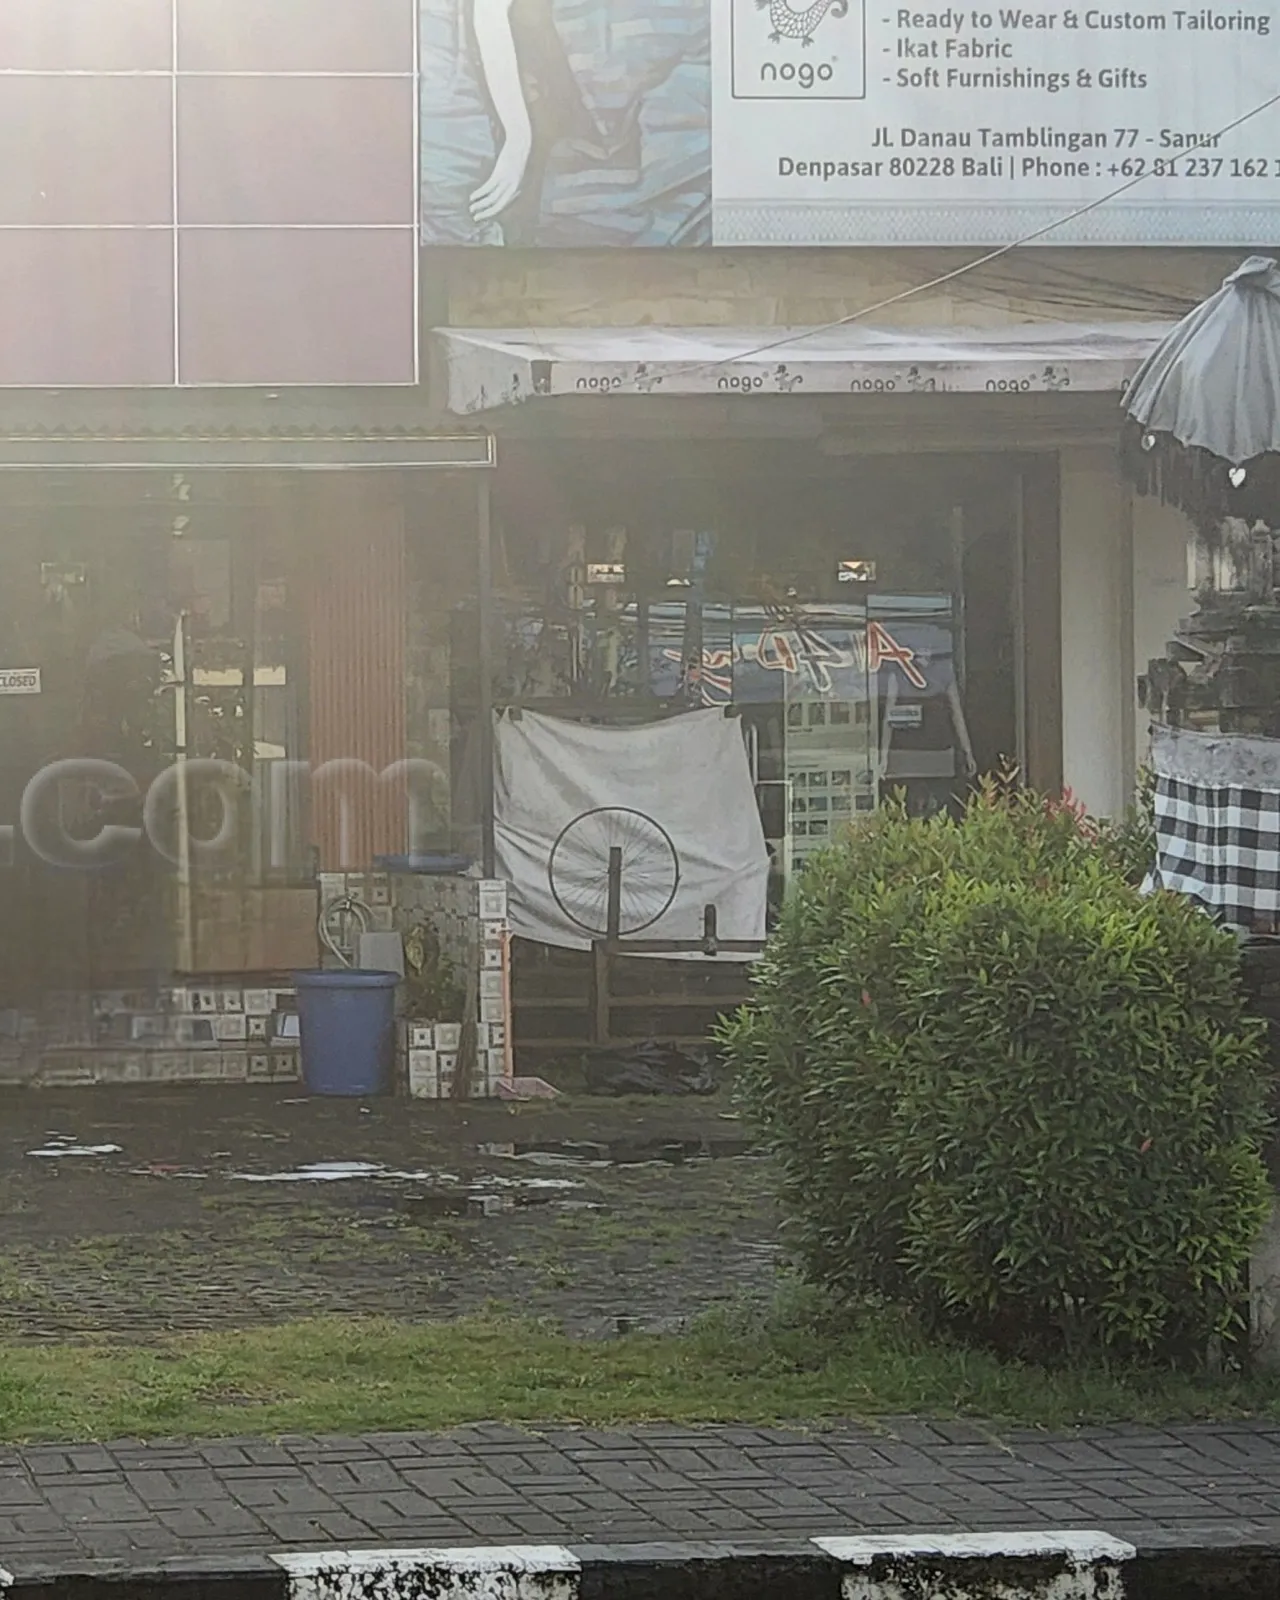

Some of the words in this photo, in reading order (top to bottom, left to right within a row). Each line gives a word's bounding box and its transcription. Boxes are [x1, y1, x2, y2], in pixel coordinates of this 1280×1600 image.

[897, 9, 964, 33] Ready
[971, 10, 993, 29] to
[999, 10, 1057, 29] Wear
[1063, 10, 1078, 29] &
[1085, 10, 1166, 30] Custom
[1172, 10, 1271, 35] Tailoring
[897, 39, 938, 58] Ikat
[945, 39, 1013, 58] Fabric
[760, 62, 834, 89] nogo
[896, 68, 940, 88] Soft
[946, 67, 1070, 92] Furnishings
[1076, 69, 1092, 88] &
[1098, 68, 1147, 88] Gifts
[901, 128, 971, 148] Danau
[978, 127, 1107, 152] Tamblingan
[1113, 129, 1139, 148] 77
[1159, 129, 1221, 148] Sanur
[778, 157, 883, 181] Denpasar
[889, 158, 955, 177] 80228
[962, 156, 1003, 177] Bali
[1022, 156, 1090, 177] Phone
[1107, 158, 1146, 177] +62
[1152, 158, 1179, 177] 81
[1185, 158, 1223, 177] 237
[1230, 158, 1268, 178] 162
[576, 376, 621, 392] nogo
[717, 376, 763, 392] nogo
[850, 378, 896, 392] nogo
[985, 378, 1031, 392] nogo
